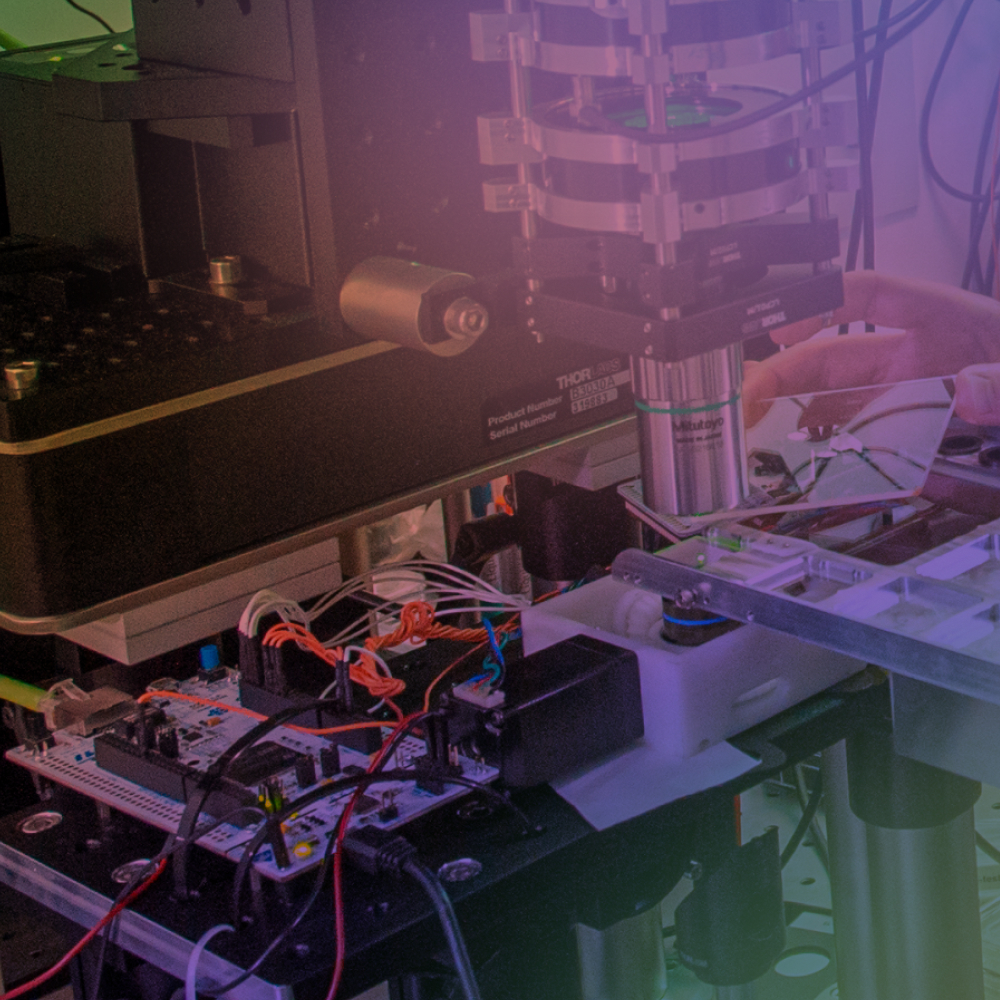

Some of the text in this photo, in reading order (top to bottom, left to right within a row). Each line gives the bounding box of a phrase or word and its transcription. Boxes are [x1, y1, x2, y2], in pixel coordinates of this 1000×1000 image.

[487, 405, 526, 427] Product
[526, 394, 564, 414] Number
[489, 423, 519, 441] Serial
[519, 410, 558, 430] Number
